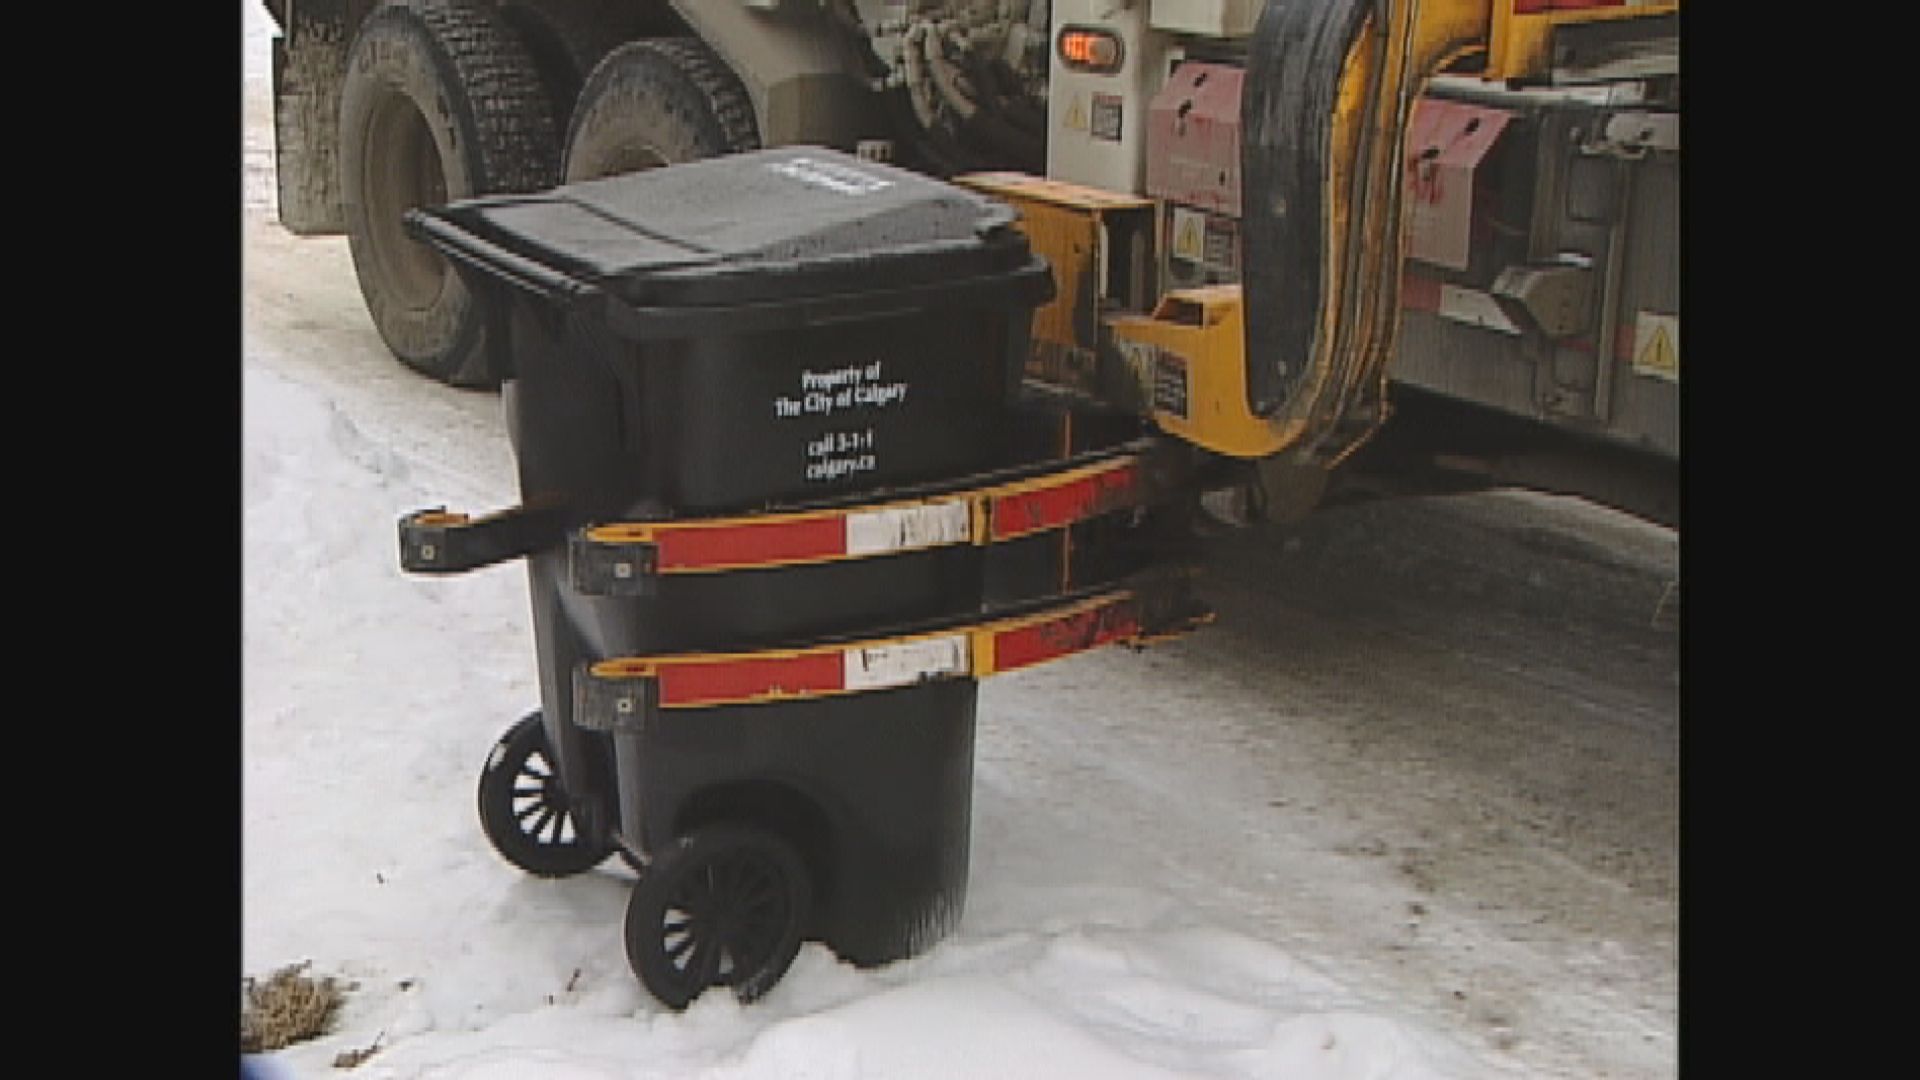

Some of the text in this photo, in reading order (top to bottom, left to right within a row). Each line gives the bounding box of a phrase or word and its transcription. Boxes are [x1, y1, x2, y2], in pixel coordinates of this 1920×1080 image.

[802, 360, 881, 393] Property of
[774, 382, 908, 416] The City of Calgary
[808, 428, 873, 456] call 3-1-1
[807, 454, 876, 480] calgary.ca
